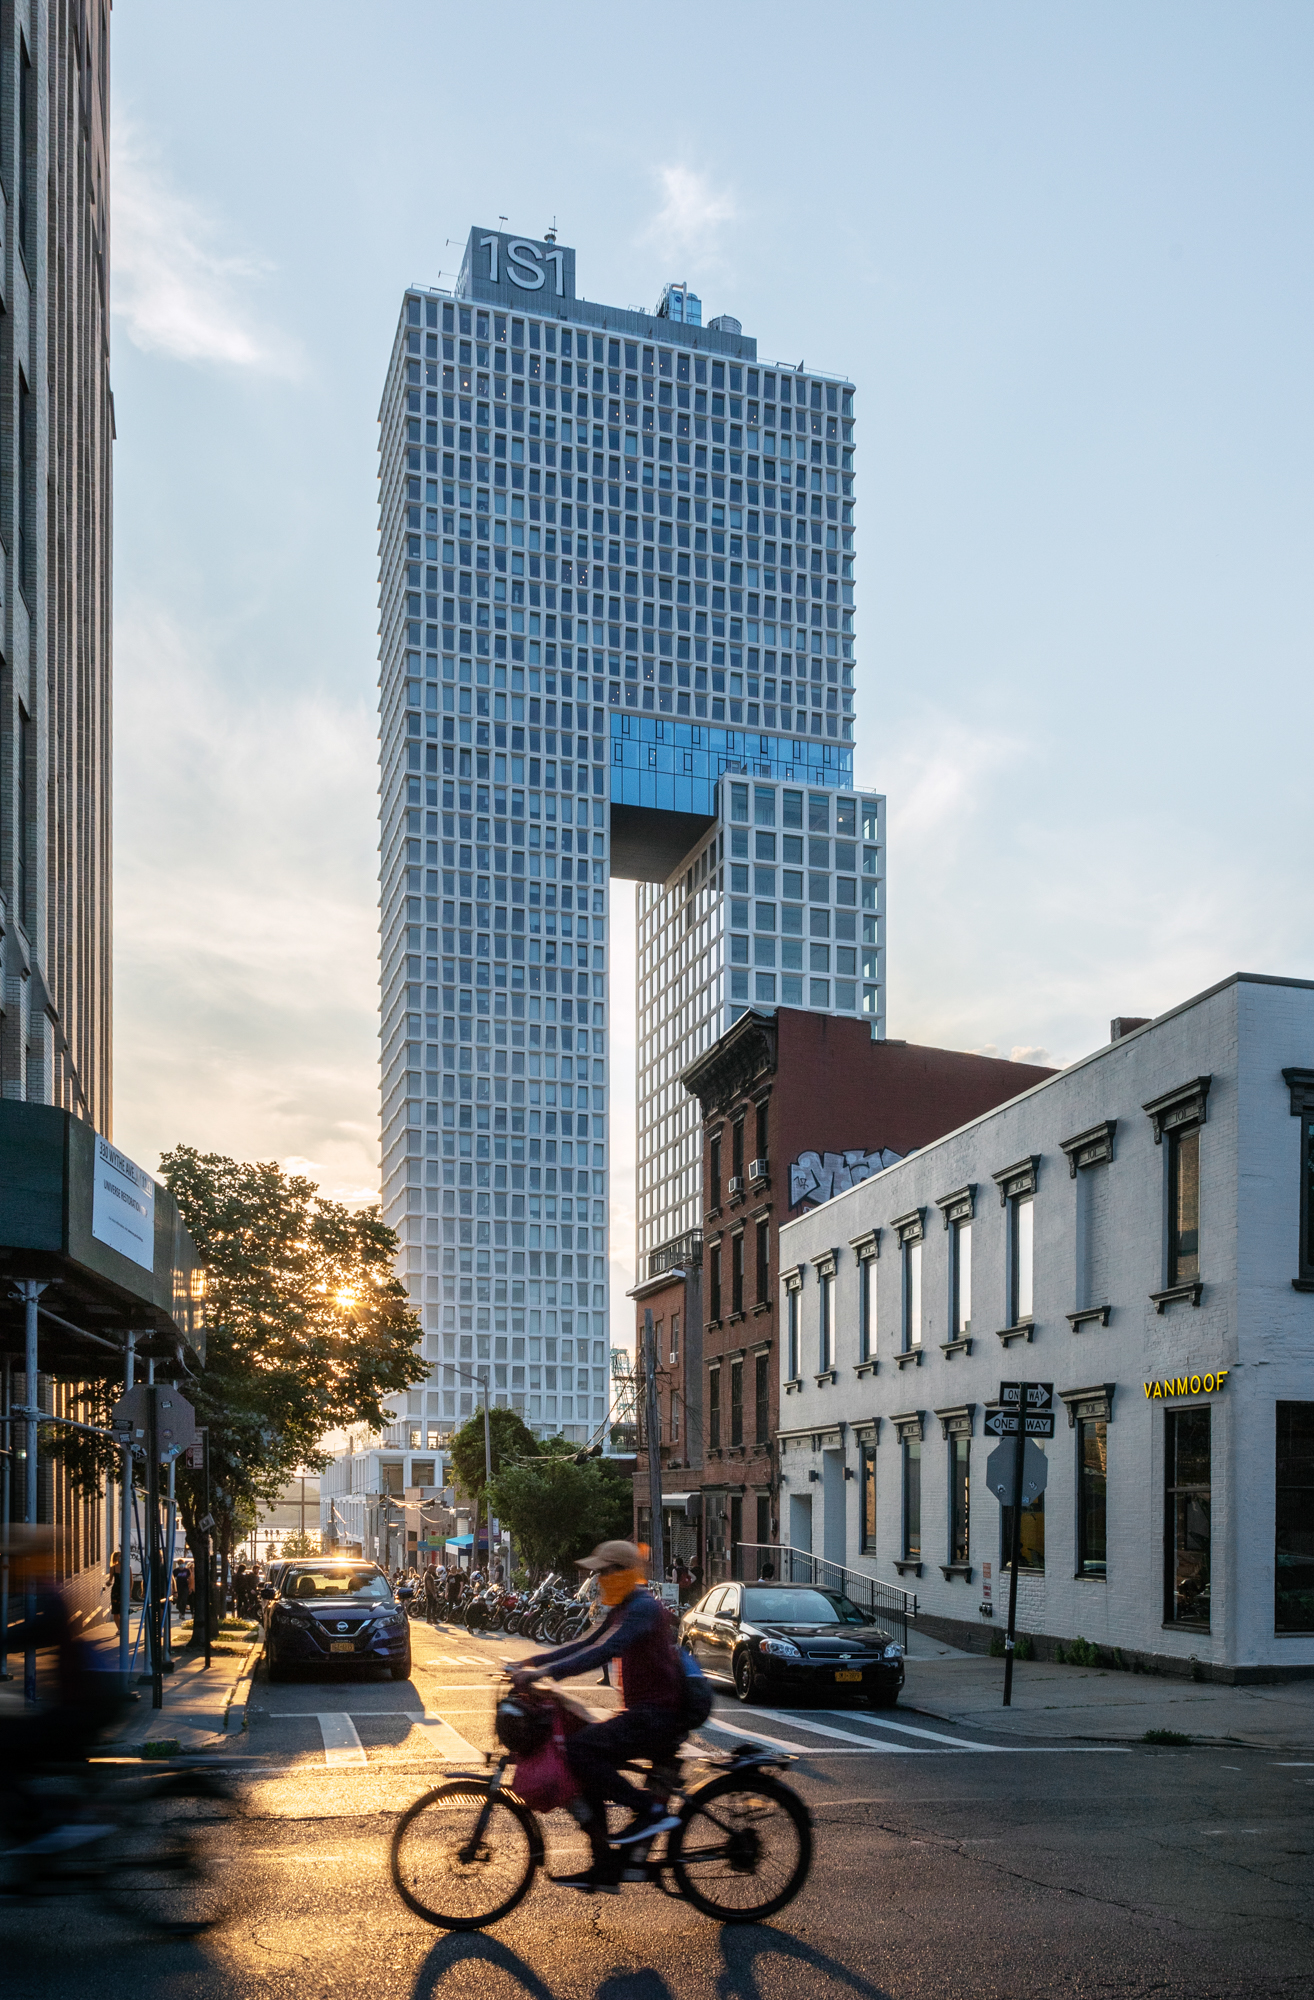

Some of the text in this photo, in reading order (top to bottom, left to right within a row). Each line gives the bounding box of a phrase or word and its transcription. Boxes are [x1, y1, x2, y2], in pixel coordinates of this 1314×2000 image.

[480, 233, 566, 298] 1S1
[99, 1141, 109, 1159] 330
[108, 1149, 125, 1172] WYTHE
[103, 1178, 121, 1199] UNIVERSE
[1007, 1389, 1045, 1401] ON WAY
[1143, 1370, 1229, 1399] VANMOOF
[993, 1418, 1049, 1431] ONE WAY
